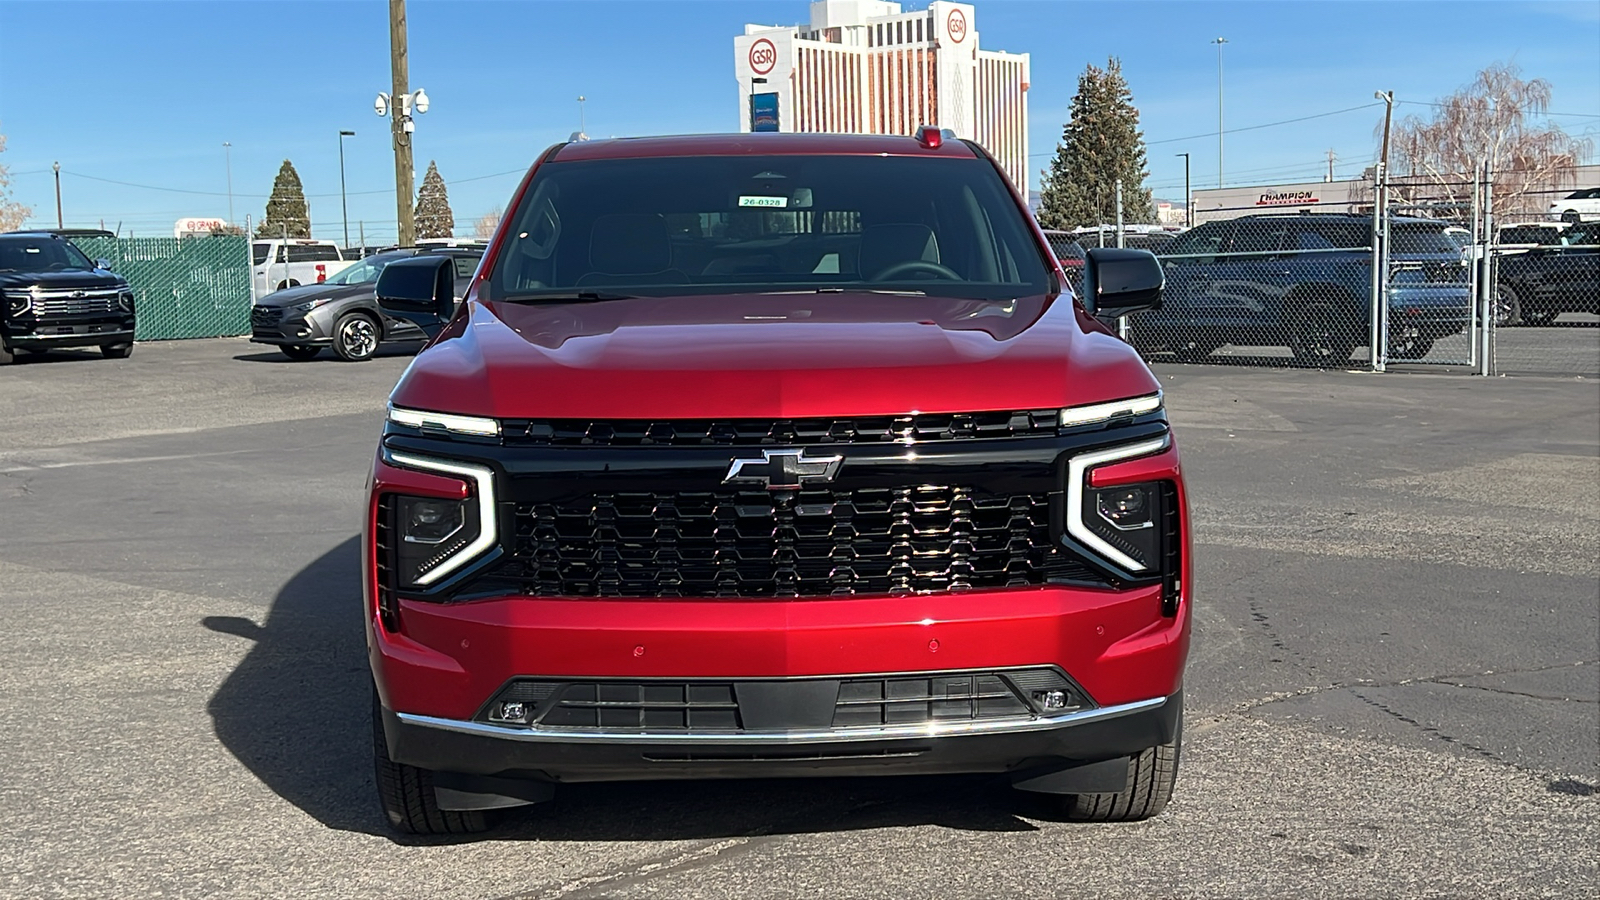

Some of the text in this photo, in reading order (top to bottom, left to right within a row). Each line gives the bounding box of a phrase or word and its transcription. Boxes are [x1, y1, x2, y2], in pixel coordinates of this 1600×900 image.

[950, 18, 963, 34] GSR
[752, 48, 773, 65] GSR
[743, 198, 781, 206] 26-0328
[1259, 191, 1313, 203] CHAMPION
